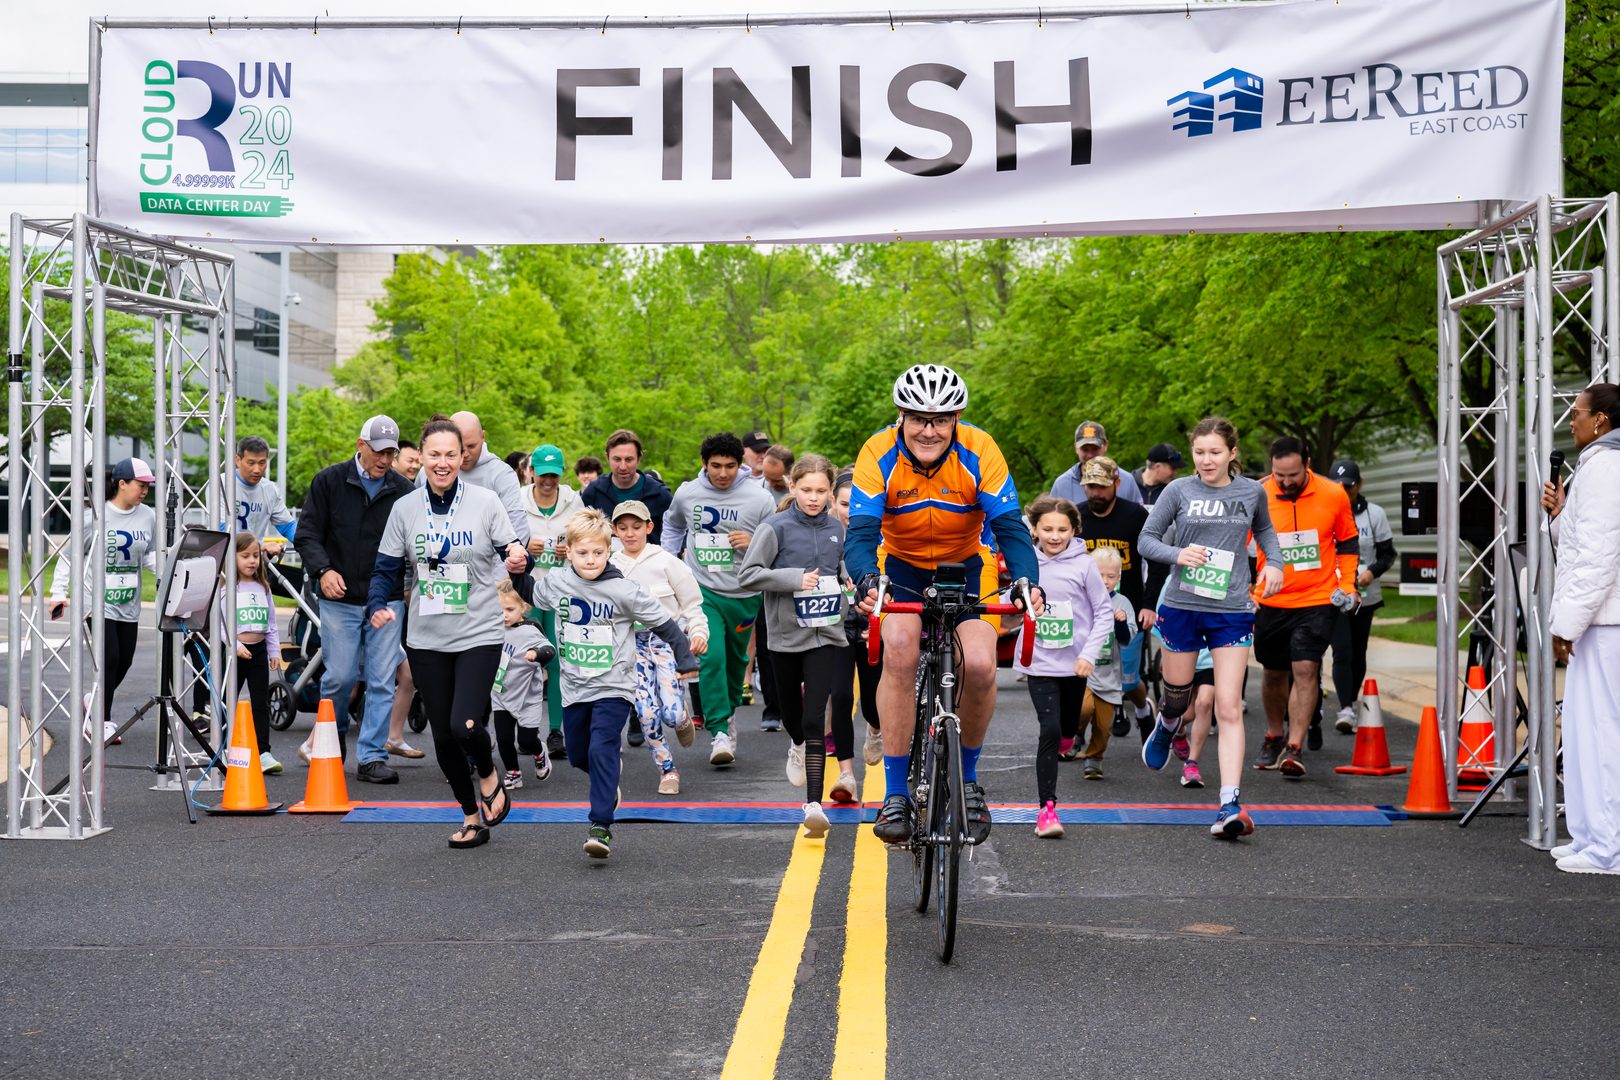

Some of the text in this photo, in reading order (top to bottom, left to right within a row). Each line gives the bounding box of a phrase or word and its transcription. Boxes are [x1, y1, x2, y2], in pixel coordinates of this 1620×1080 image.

[140, 60, 175, 186] CLOUD
[239, 105, 292, 145] 20
[555, 56, 1092, 181] FINISH
[1410, 113, 1529, 136] EAST COAST
[240, 150, 294, 190] 24
[172, 173, 236, 189] 4.99999K
[148, 198, 271, 212] DATA CENTER DAY
[698, 550, 731, 562] 3002
[1282, 546, 1317, 562] 3043
[1185, 566, 1226, 587] 3024
[107, 589, 134, 601] 3014
[798, 597, 838, 614] 1227
[239, 608, 267, 621] 3001
[568, 645, 609, 663] 3022
